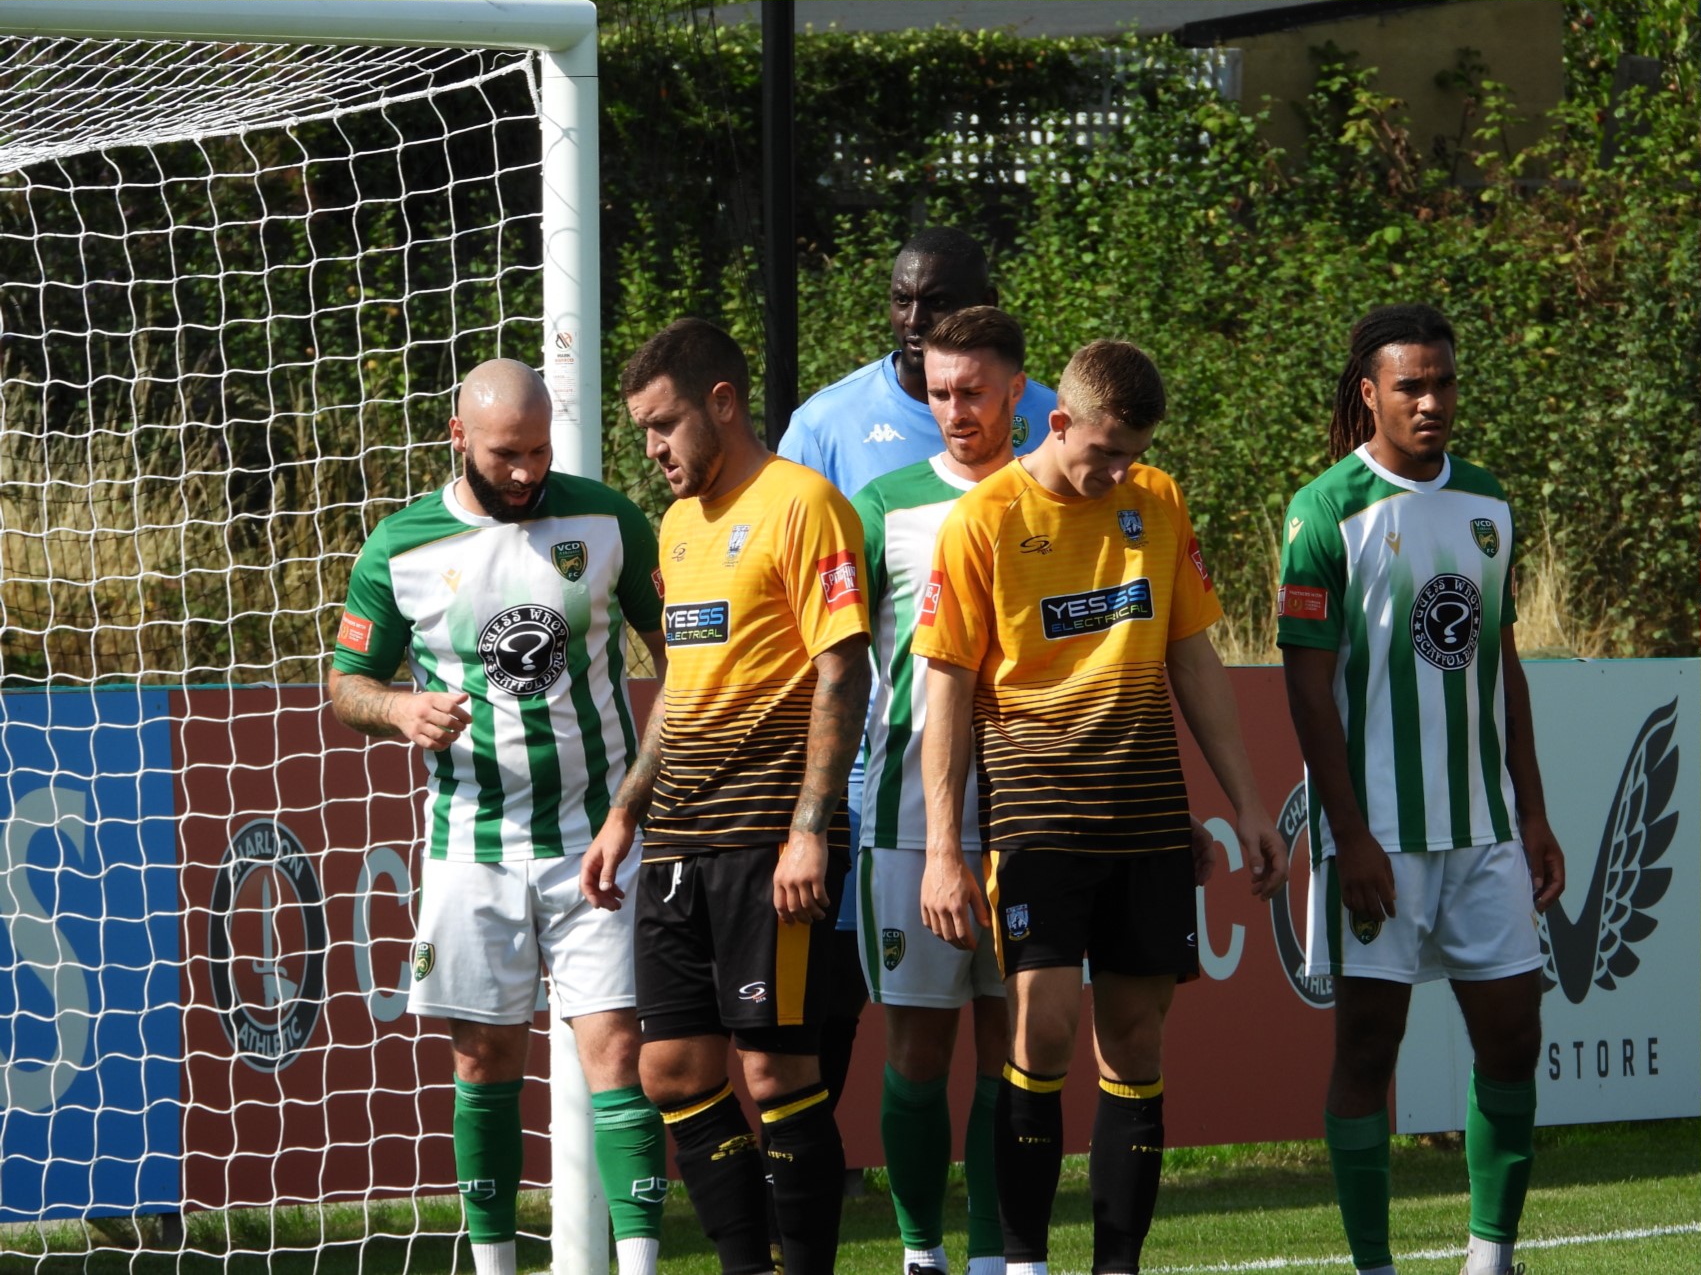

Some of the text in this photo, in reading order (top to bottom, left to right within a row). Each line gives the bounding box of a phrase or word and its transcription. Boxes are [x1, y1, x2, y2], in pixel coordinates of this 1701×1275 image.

[1473, 519, 1492, 528] VCD
[556, 541, 581, 552] VCD
[665, 606, 724, 628] YESSS
[1047, 582, 1148, 621] YESSS
[1414, 578, 1447, 618] GUESS
[482, 609, 522, 653] GUESS
[665, 628, 723, 642] ELECTRICAL
[1051, 603, 1149, 633] ELECTRICAL
[1414, 630, 1479, 666] SCAFFOLDING
[486, 651, 564, 692] SCAFFOLDING
[229, 828, 305, 883] CHARLTON
[236, 1015, 304, 1058] ATHLETIC
[1548, 1036, 1660, 1082] STORE
